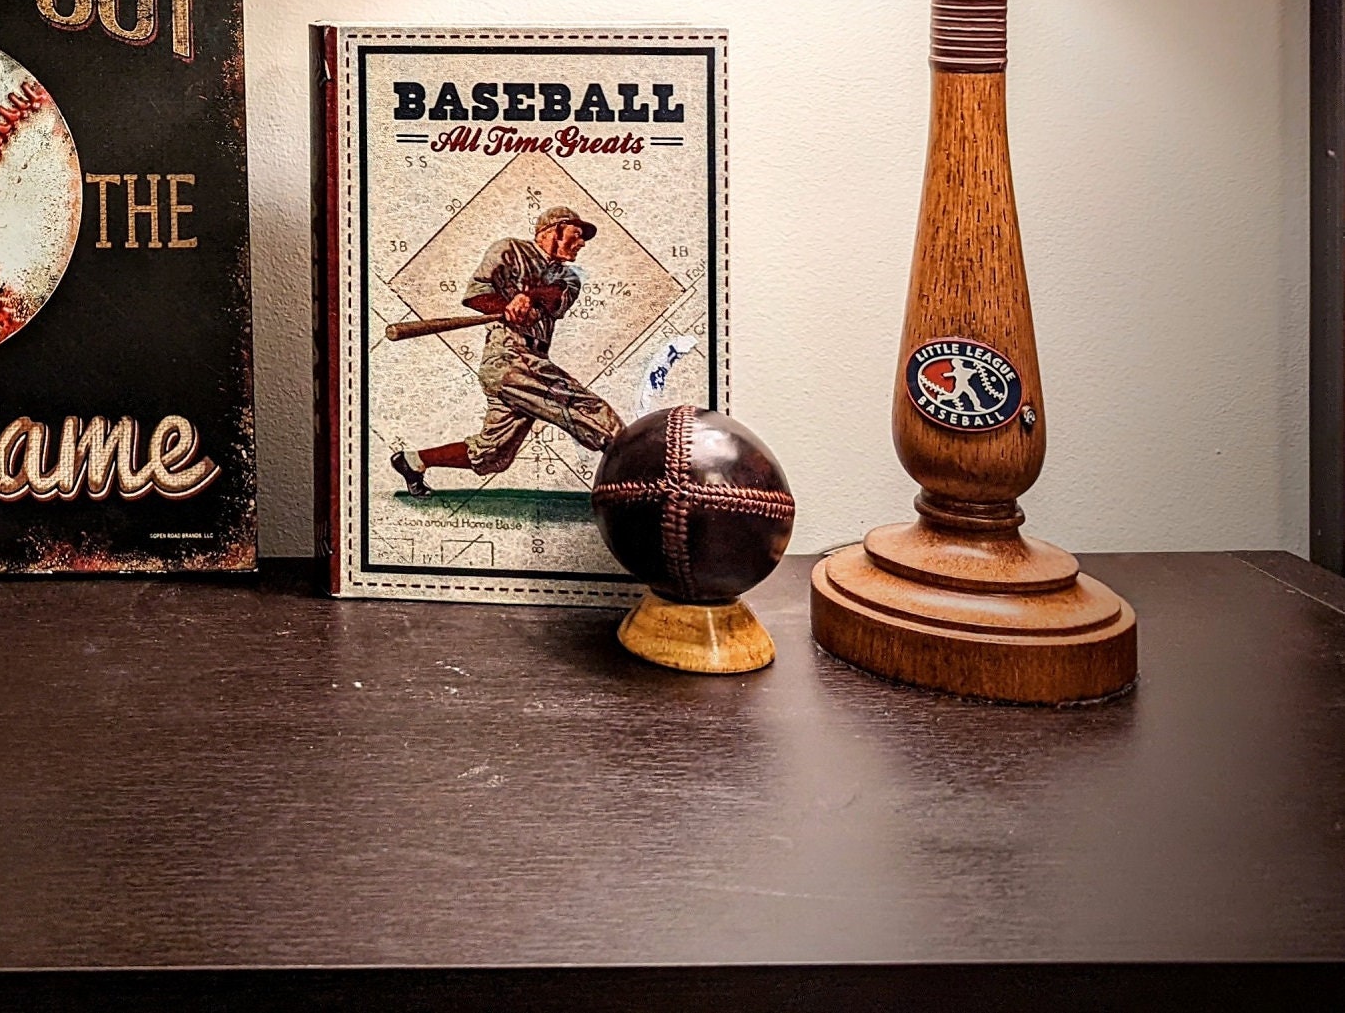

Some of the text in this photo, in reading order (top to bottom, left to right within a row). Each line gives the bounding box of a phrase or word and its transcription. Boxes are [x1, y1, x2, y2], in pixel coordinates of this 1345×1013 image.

[393, 82, 685, 122] BASEBALL
[431, 126, 645, 158] All Time Greats
[86, 173, 197, 248] THE
[915, 343, 1016, 382] LITTLE LEAGUE
[917, 395, 1005, 426] BASEBALL
[424, 518, 459, 528] around
[461, 518, 494, 529] Home
